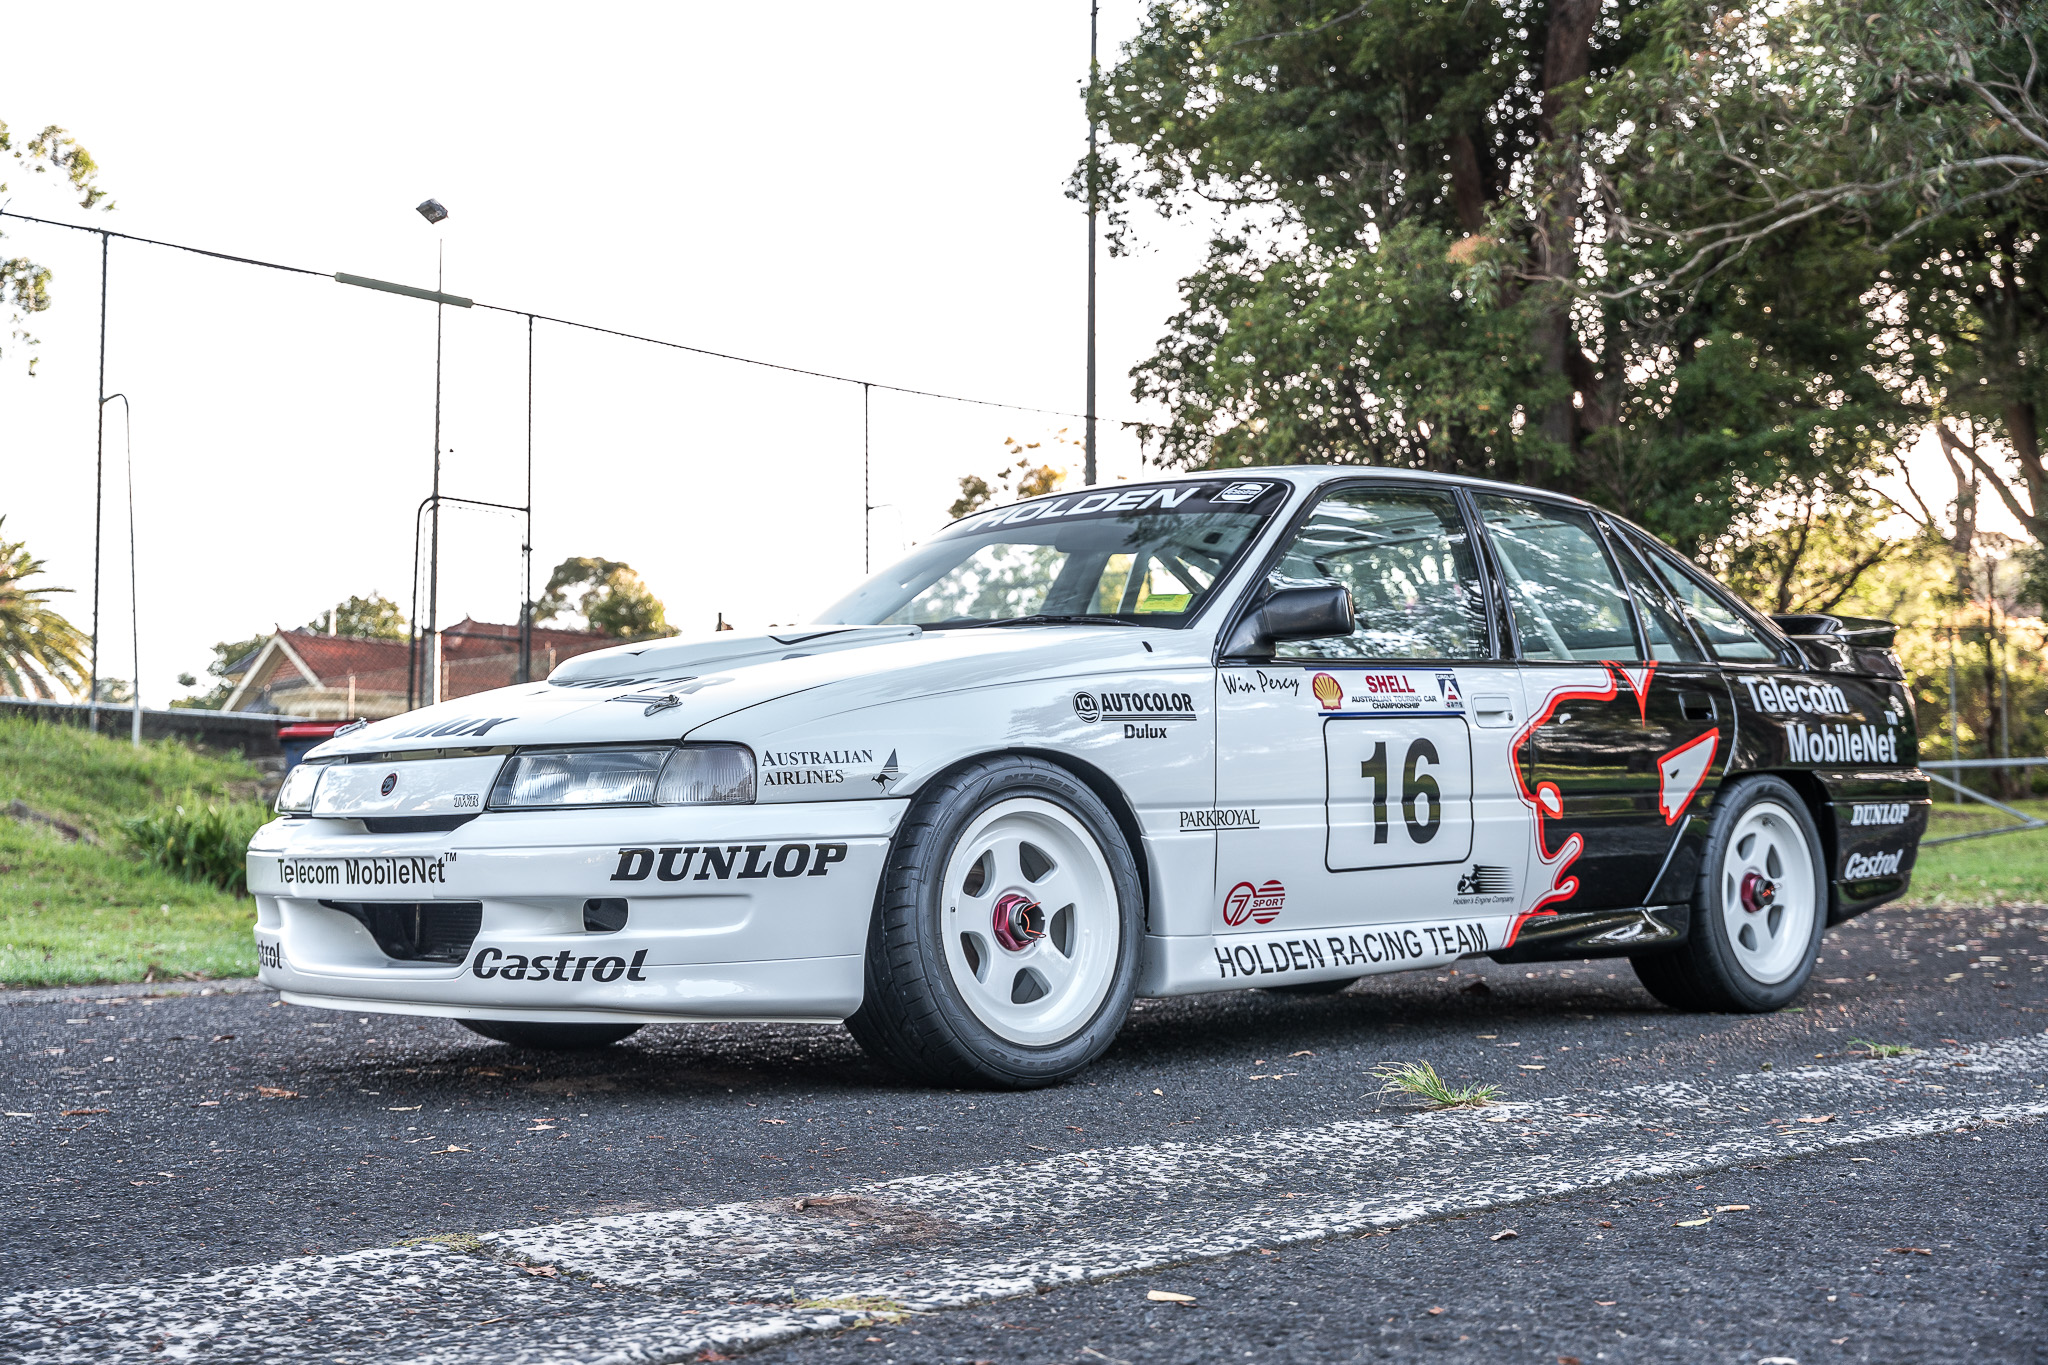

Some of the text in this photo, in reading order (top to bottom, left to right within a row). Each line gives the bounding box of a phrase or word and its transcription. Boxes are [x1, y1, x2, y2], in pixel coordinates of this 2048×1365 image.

[967, 487, 1200, 532] HOLDEN
[1221, 670, 1300, 696] Win Percy
[1365, 675, 1416, 693] SHELL
[1738, 676, 1850, 714] Telecom
[1077, 697, 1094, 711] ICI
[1101, 693, 1195, 712] AUTOCOLOR
[1124, 724, 1167, 739] Dulux
[1785, 724, 1898, 763] MobileNet
[762, 750, 874, 767] AUSTRALIAN
[763, 769, 845, 786] AIRLINES
[454, 793, 480, 808] TWR
[1361, 738, 1441, 845] 16
[1179, 809, 1261, 828] PARKROYAL
[1851, 803, 1910, 826] DUNLOP
[278, 857, 446, 884] Telecom MobileNet
[610, 842, 848, 882] DUNLOP
[1844, 849, 1903, 880] Castrol
[1252, 897, 1286, 908] SPORT
[257, 940, 282, 969] strol
[1214, 923, 1489, 978] HOLDEN RACING TEAM
[472, 947, 649, 982] Castrol
